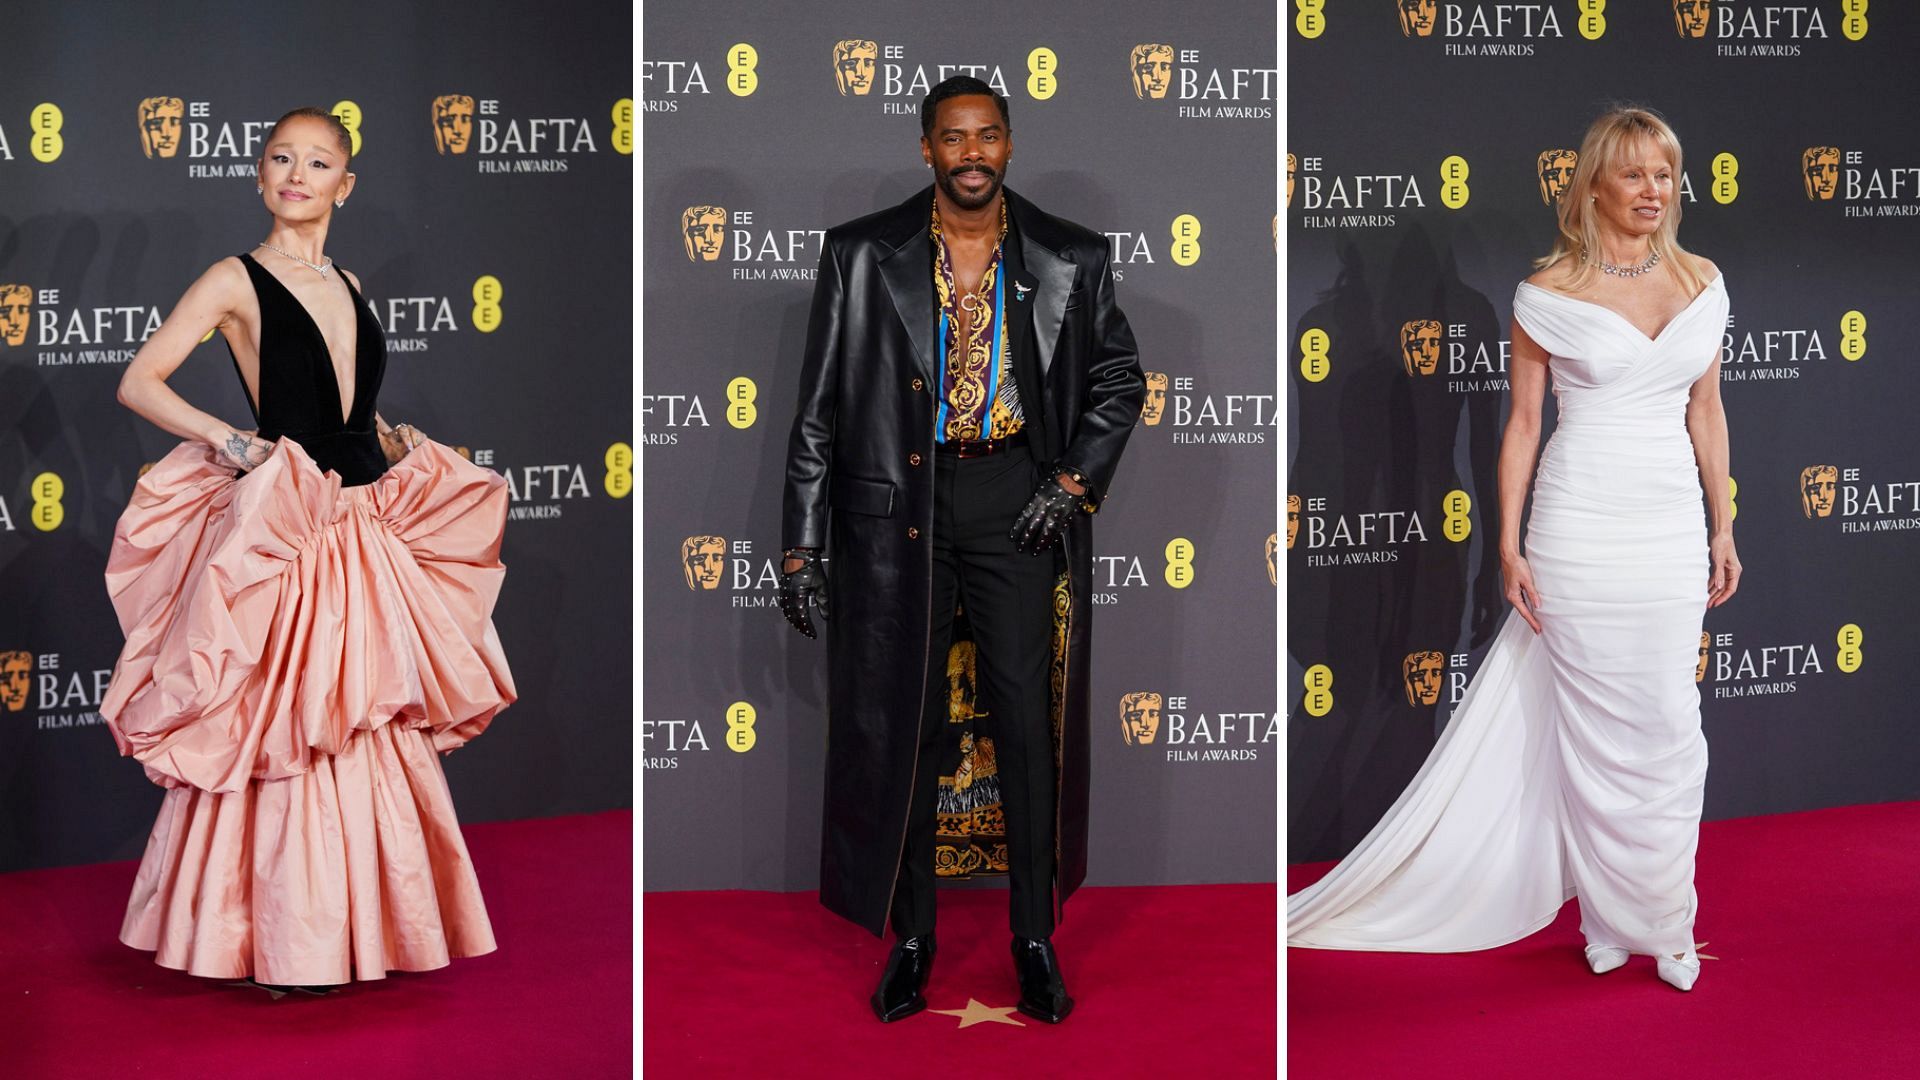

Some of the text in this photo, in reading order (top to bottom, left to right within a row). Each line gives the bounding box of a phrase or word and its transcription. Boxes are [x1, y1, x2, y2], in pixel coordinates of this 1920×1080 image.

[1445, 4, 1563, 38] BAFTA
[1717, 6, 1828, 39] BAFTA
[884, 46, 904, 59] EE
[1180, 50, 1200, 63] EE
[1445, 44, 1535, 57] FILM AWARDS
[1717, 45, 1801, 57] FILM AWARDS
[1179, 67, 1277, 100] BAFT
[189, 102, 210, 117] EE
[479, 100, 499, 115] EE
[883, 102, 917, 115] FILM
[1179, 106, 1272, 119] FILM AWARDS
[478, 117, 598, 154] BAFTA
[1303, 157, 1323, 171] EE
[1845, 151, 1863, 164] EE
[189, 165, 223, 178] FILM
[478, 159, 568, 173] FILM AWARDS
[1303, 175, 1426, 209] BAFTA
[733, 211, 753, 225] EE
[1845, 206, 1873, 217] FILM
[1304, 214, 1396, 229] FILM AWARDS
[733, 268, 766, 280] FILM
[38, 289, 60, 305] EE
[1448, 324, 1466, 338] EE
[38, 352, 73, 366] FILM
[1749, 367, 1800, 381] AWARDS
[1175, 377, 1193, 390] EE
[1448, 381, 1479, 393] FILM
[1173, 433, 1265, 444] FILM AWARDS
[474, 450, 494, 465] EE
[1843, 468, 1860, 482] EE
[1308, 498, 1326, 511] EE
[508, 504, 562, 521] AWARDS
[1307, 510, 1428, 549] BAFTA
[1842, 520, 1870, 533] FILM
[733, 540, 752, 554] EE
[1308, 550, 1398, 567] FILM AWARDS
[732, 596, 765, 607] FILM
[1716, 633, 1733, 646] EE
[38, 653, 59, 670] EE
[1450, 654, 1468, 667] EE
[1715, 643, 1824, 682] BAFTA
[1715, 681, 1797, 699] FILM AWARDS
[1168, 696, 1187, 710] EE
[38, 714, 73, 729] FILM
[1167, 748, 1257, 761] FILM AWARDS
